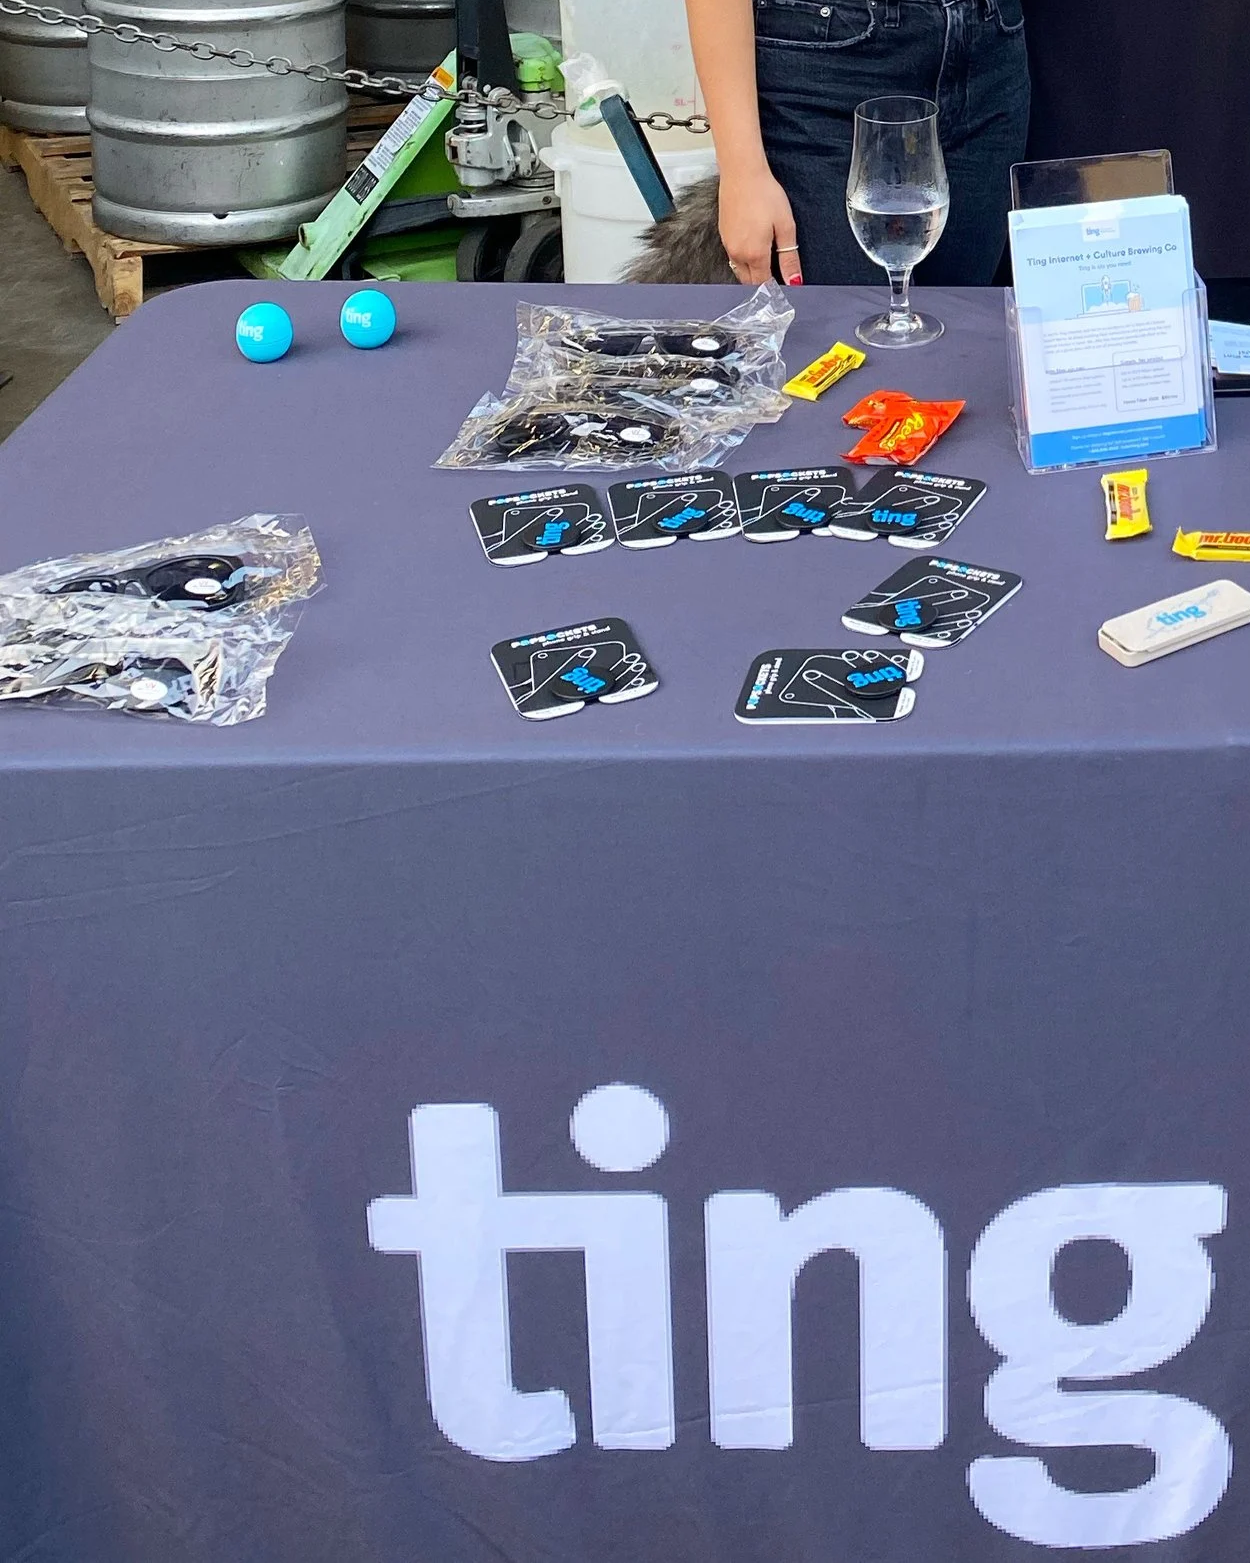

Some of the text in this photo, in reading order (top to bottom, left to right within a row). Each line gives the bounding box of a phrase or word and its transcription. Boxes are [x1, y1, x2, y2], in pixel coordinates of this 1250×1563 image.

[1027, 257, 1047, 267] Ting
[1049, 253, 1084, 265] Internet
[1093, 249, 1126, 259] Culture
[1128, 245, 1162, 256] Brewing
[1164, 243, 1177, 252] Co
[344, 307, 372, 328] ting
[237, 319, 264, 342] ting
[626, 475, 702, 489] POPSOCKETS
[751, 469, 826, 480] POPSOCKETS
[894, 471, 965, 486] POPSOCKETS
[488, 489, 566, 506] POPSOCKETS
[657, 507, 706, 529] ting
[782, 503, 826, 524] ting
[872, 508, 917, 527] ting
[536, 521, 570, 545] ting
[929, 560, 1000, 580] POPSOCKETS
[895, 598, 922, 628] ting
[1156, 603, 1207, 627] ting
[511, 624, 597, 648] POPSOCKETS
[560, 667, 606, 694] ting
[746, 664, 772, 710] POPSOCKETS
[847, 665, 903, 689] ting
[366, 1082, 1233, 1549] ting
